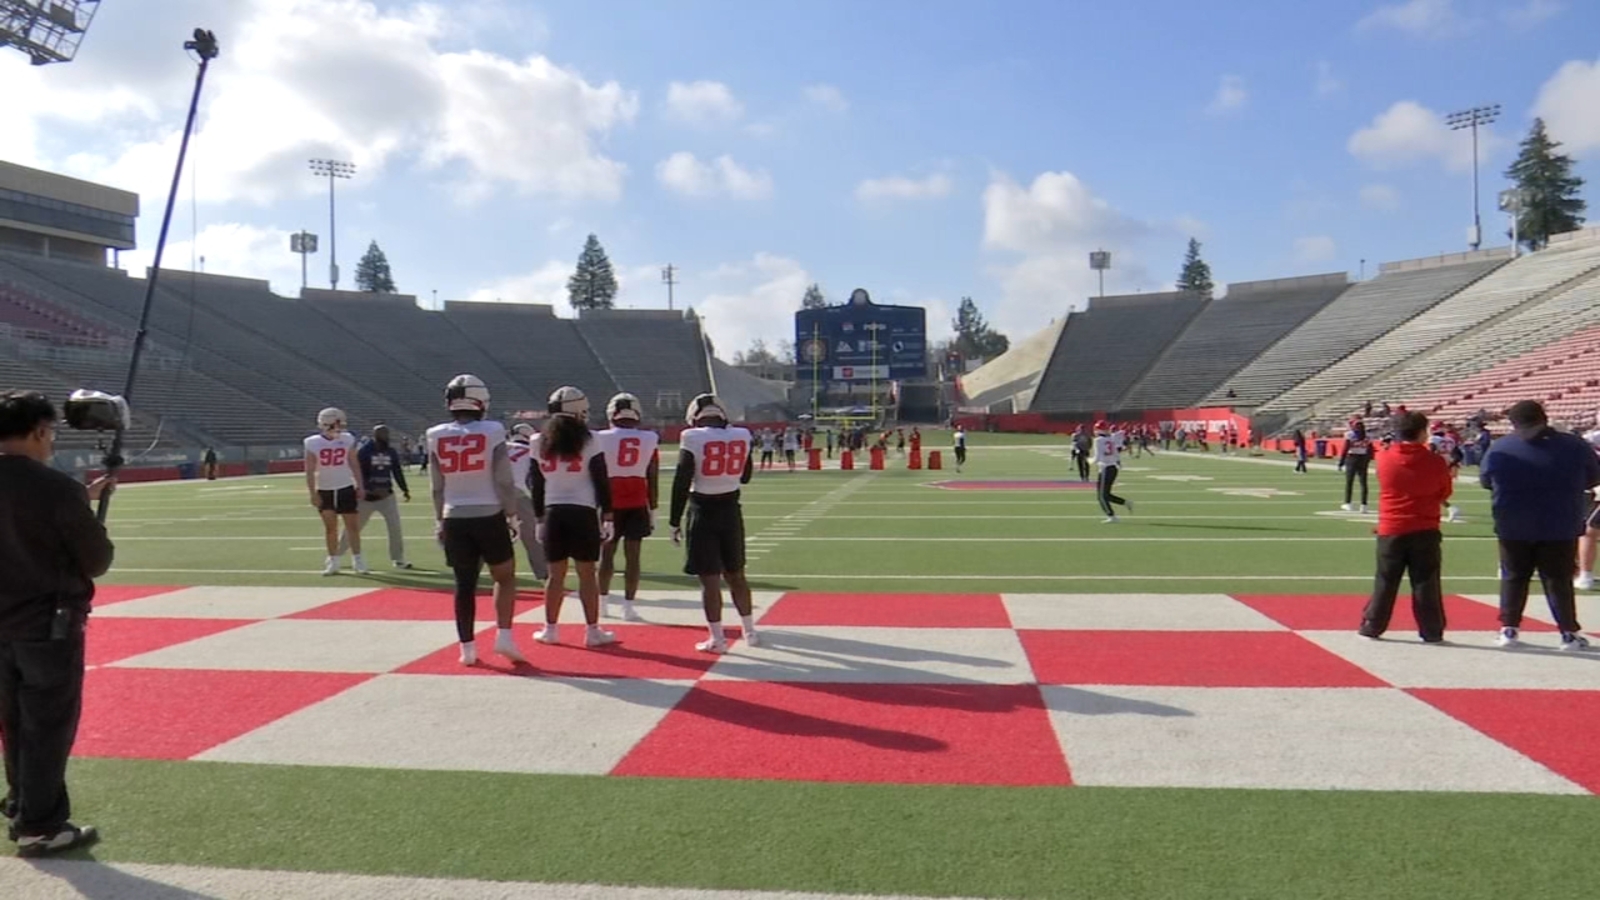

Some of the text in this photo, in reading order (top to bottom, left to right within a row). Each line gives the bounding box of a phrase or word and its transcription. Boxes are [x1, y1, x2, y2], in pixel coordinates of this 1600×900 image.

[320, 447, 346, 466] 92
[438, 433, 486, 472] 52
[617, 437, 640, 467] 6
[702, 440, 746, 476] 88
